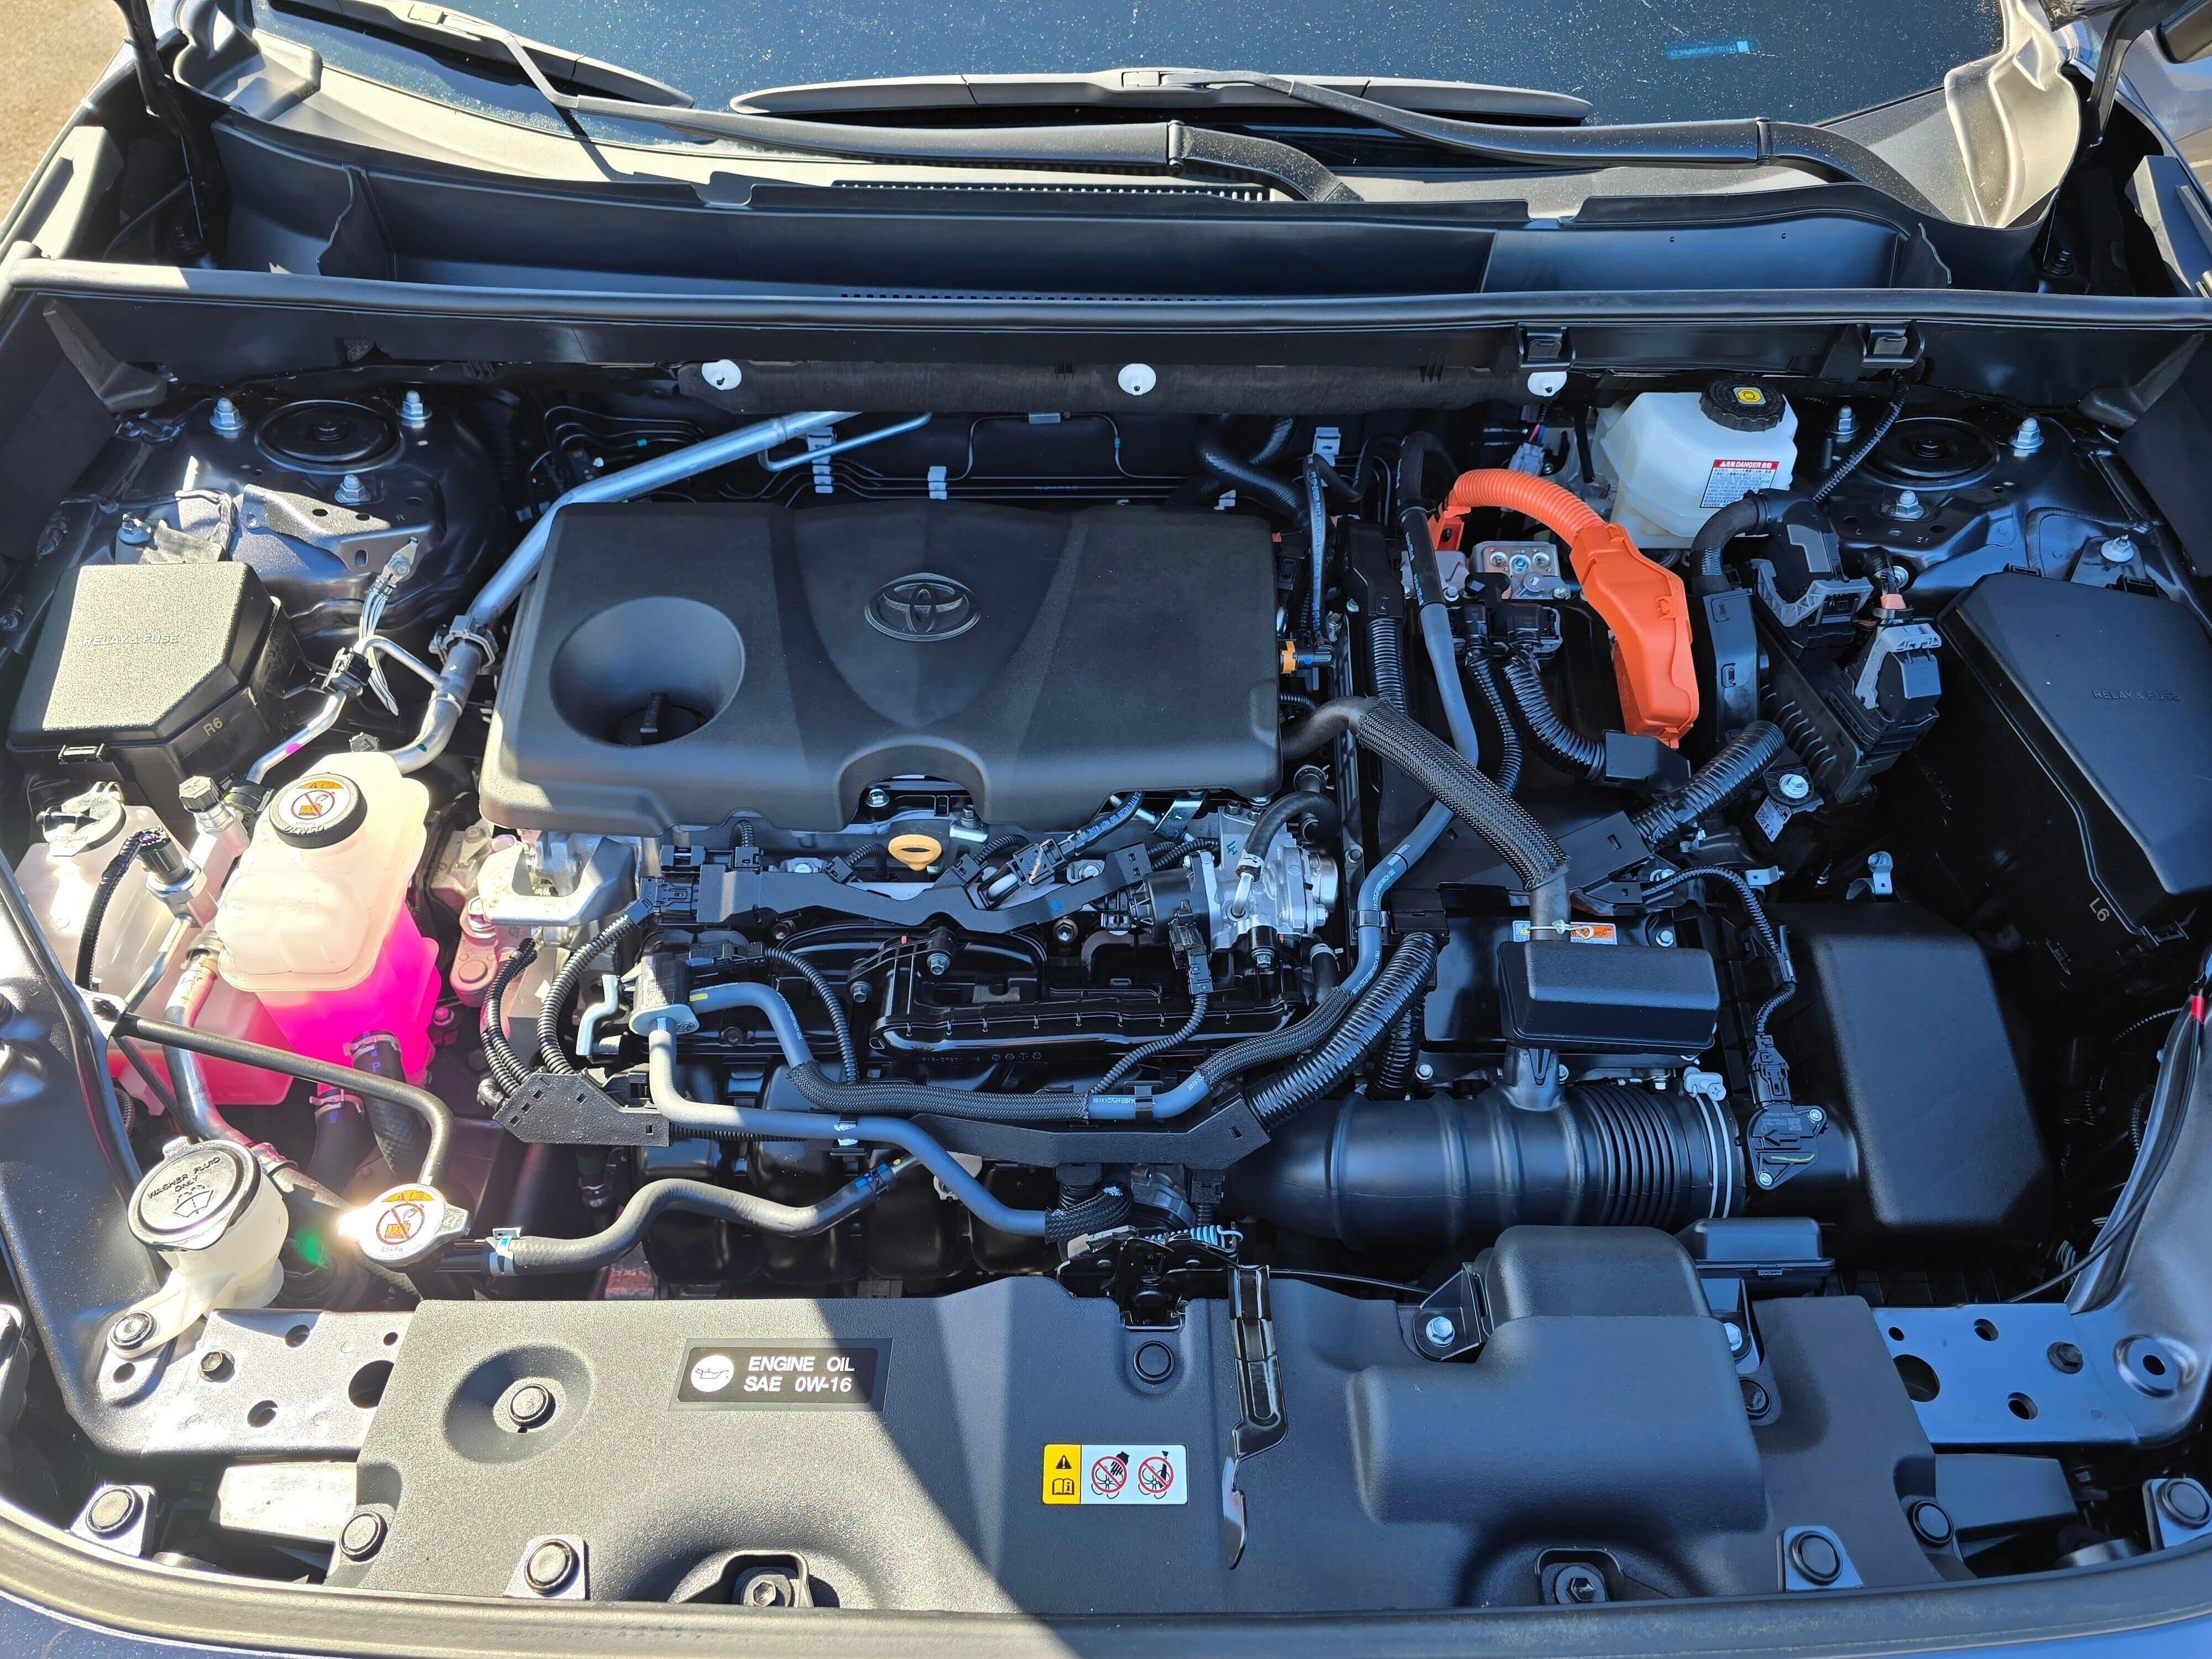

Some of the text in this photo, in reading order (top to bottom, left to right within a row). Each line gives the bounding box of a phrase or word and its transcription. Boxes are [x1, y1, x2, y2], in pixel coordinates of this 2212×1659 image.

[82, 633, 179, 646] RELAY & FUSE
[2092, 690, 2133, 700] RELAY
[2146, 691, 2181, 702] FUSE
[203, 717, 223, 737] R6
[284, 825, 326, 834] DENSO
[2090, 898, 2109, 921] L6
[372, 1062, 380, 1072] P
[148, 1156, 221, 1199] WASHER FLUID
[174, 1175, 199, 1192] ONLY
[748, 1357, 855, 1371] ENGINE OIL
[743, 1376, 852, 1392] SAE 0W-16
